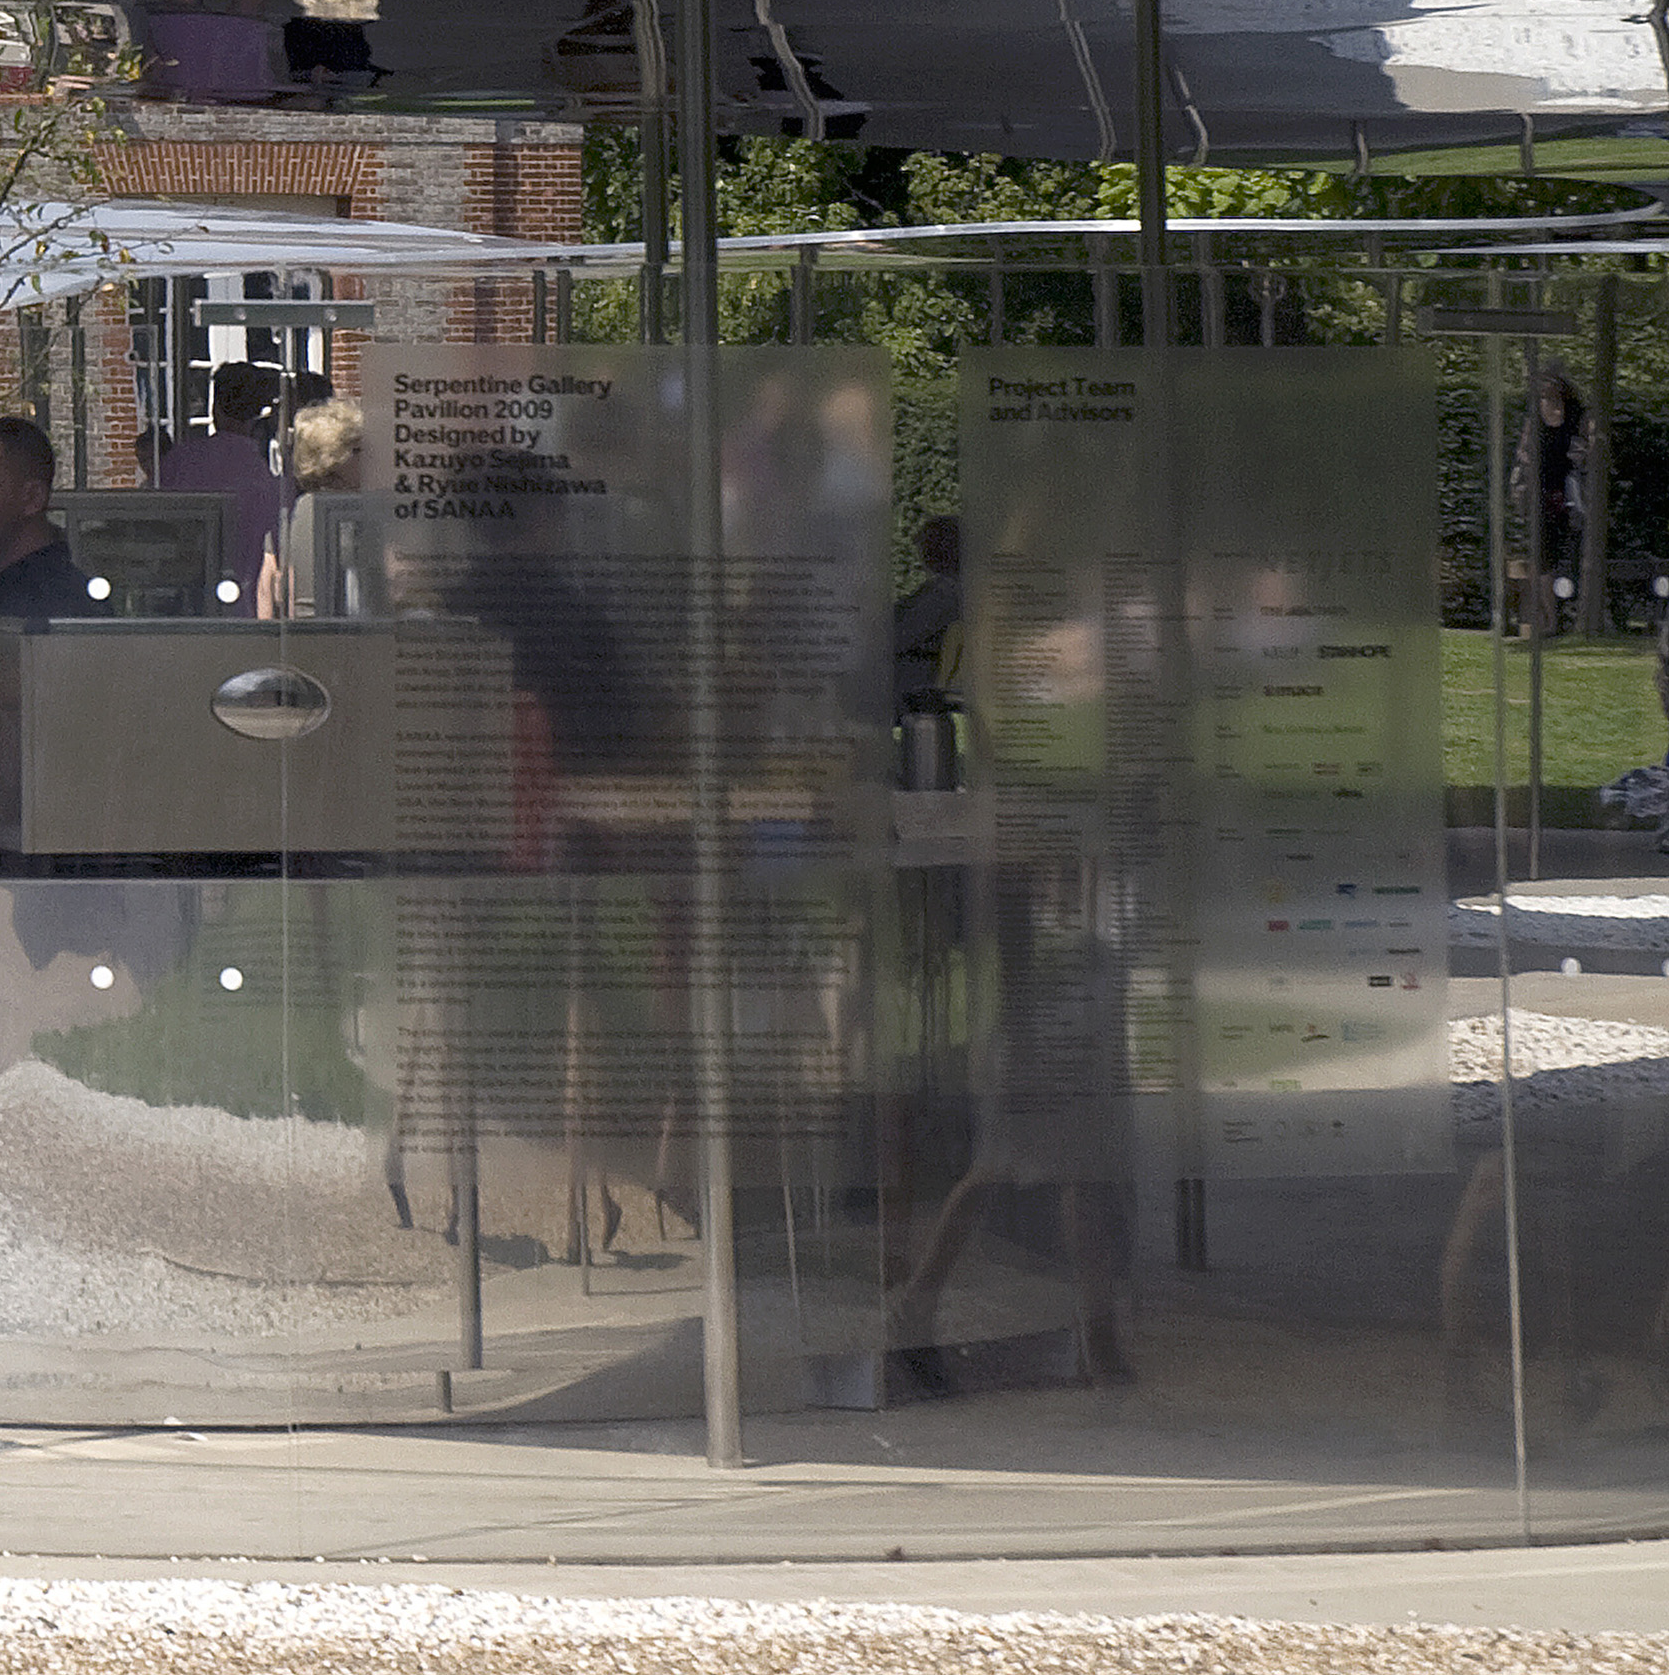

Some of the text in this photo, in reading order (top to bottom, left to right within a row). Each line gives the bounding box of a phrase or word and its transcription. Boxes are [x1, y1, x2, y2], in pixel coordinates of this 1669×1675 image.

[394, 374, 612, 400] Serpentine Gallery
[988, 376, 1136, 401] Project Team
[394, 399, 554, 420] Pavilion 2009
[989, 401, 1134, 422] and Advisors
[394, 424, 542, 449] Designed by
[394, 448, 485, 473] Kazuyo
[394, 474, 412, 495] &
[418, 474, 479, 498] Ryue
[394, 498, 515, 519] of SANAA
